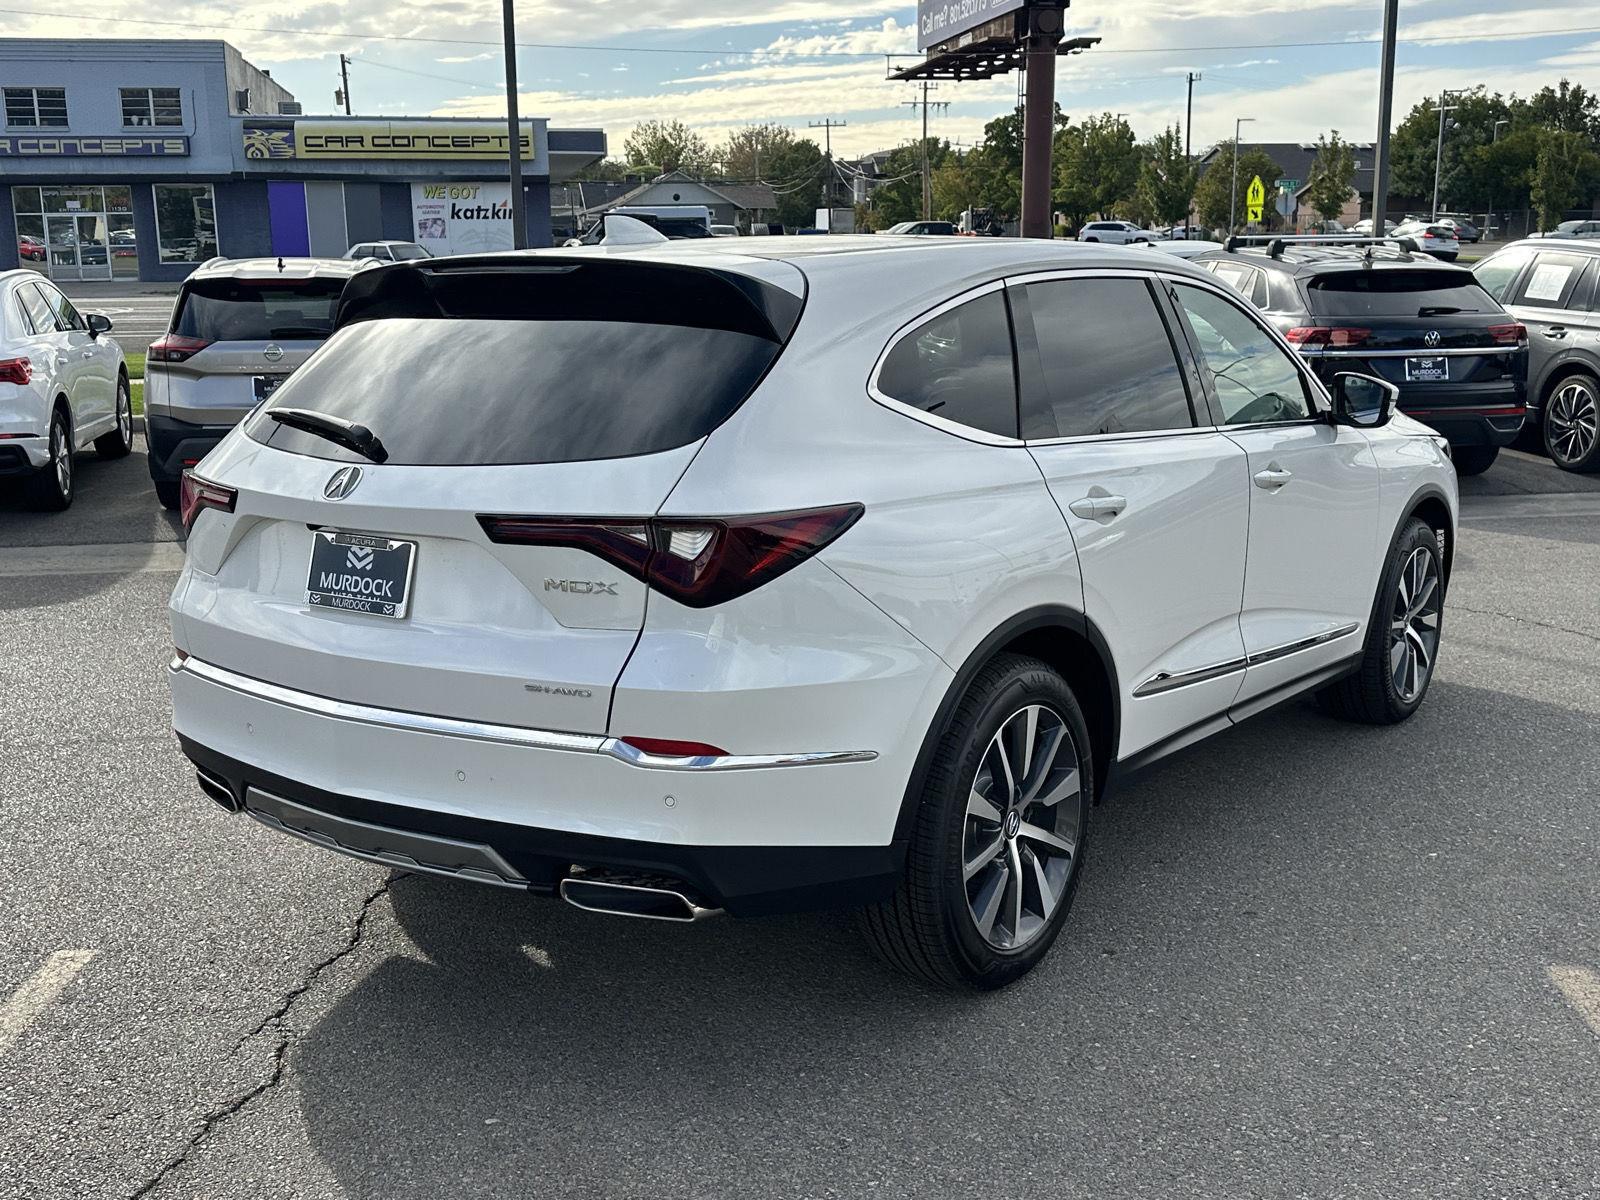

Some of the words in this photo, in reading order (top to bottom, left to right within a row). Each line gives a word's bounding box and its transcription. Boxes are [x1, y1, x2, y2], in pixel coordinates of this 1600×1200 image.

[922, 12, 933, 36] Call
[934, 4, 948, 31] me?
[18, 139, 186, 154] CONCEPTS
[304, 136, 364, 148] CAR
[372, 136, 530, 148] CONCEPTS
[424, 185, 446, 200] WE
[448, 185, 480, 200] GOT
[351, 537, 377, 547] ACURA
[320, 571, 394, 597] MURDOCK
[543, 578, 618, 596] MDX
[331, 597, 371, 612] MURDOCK
[524, 684, 592, 698] SH-AWD
